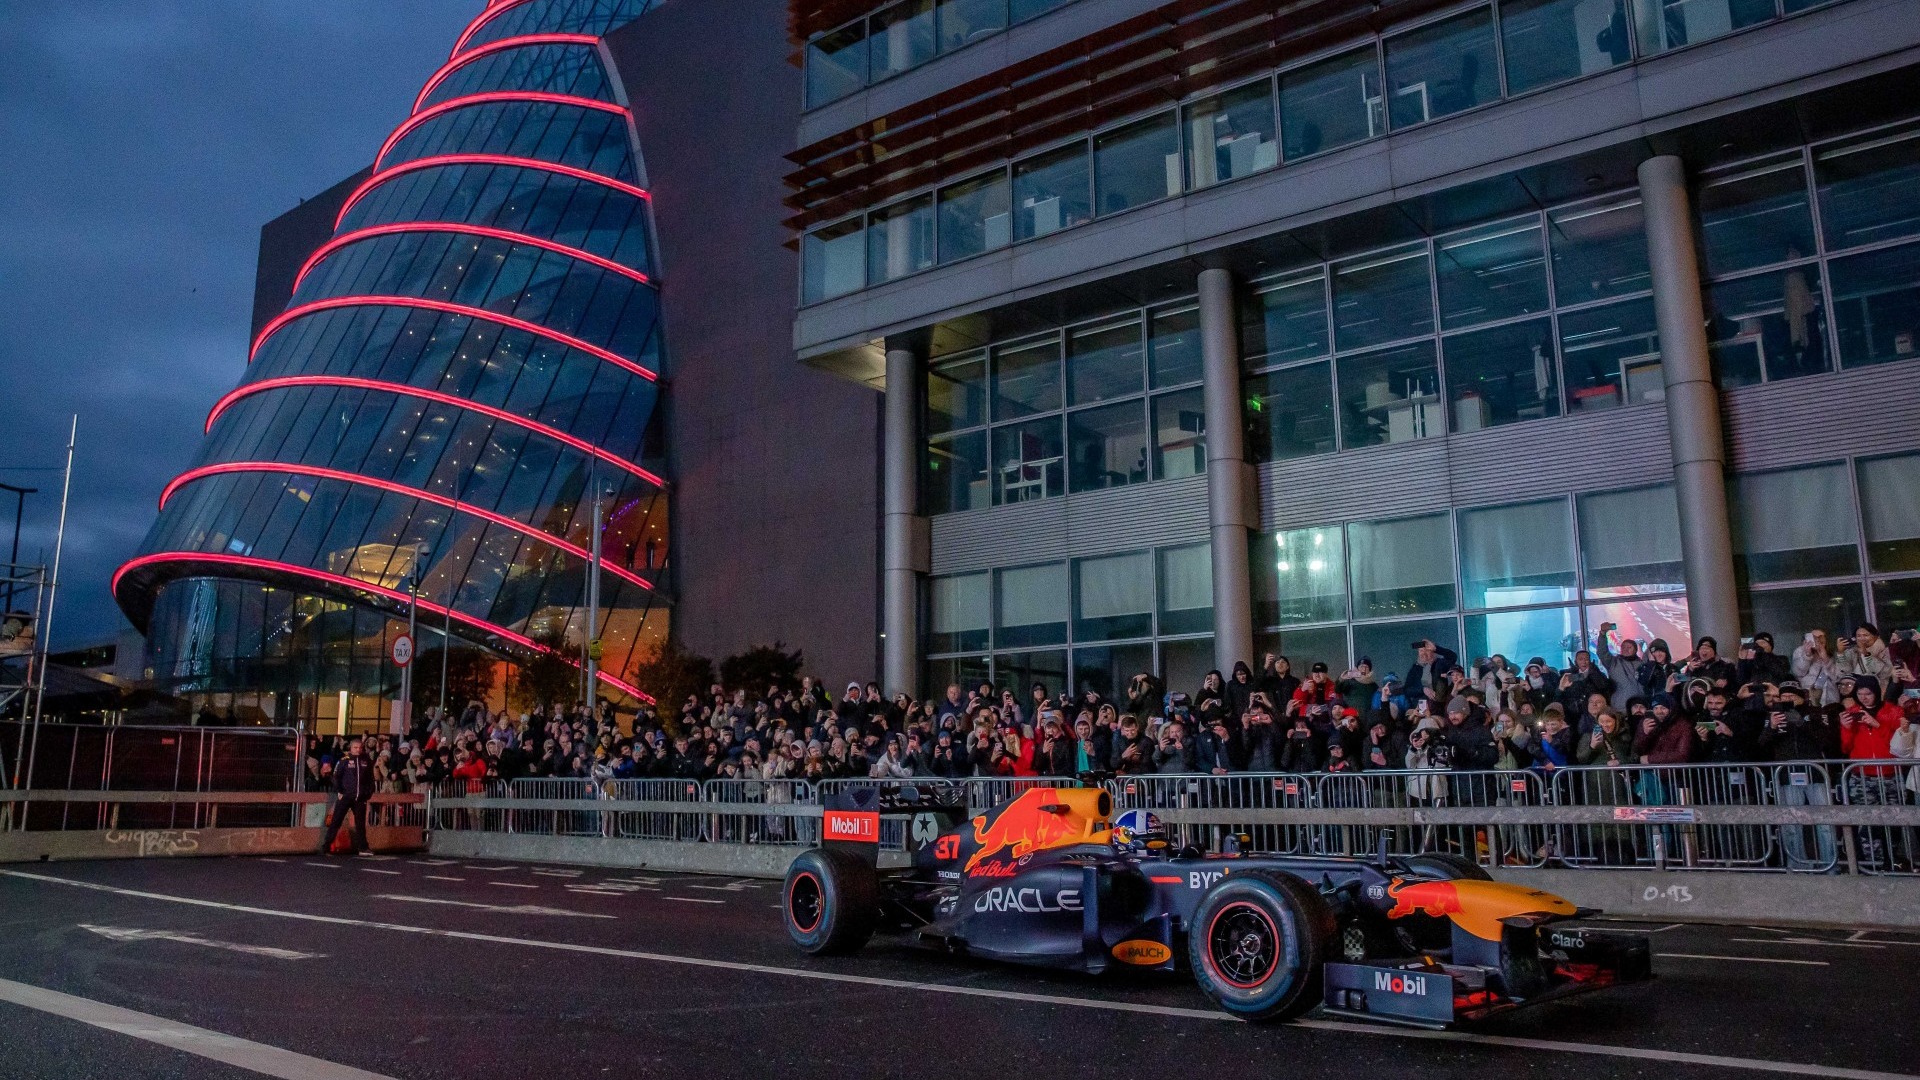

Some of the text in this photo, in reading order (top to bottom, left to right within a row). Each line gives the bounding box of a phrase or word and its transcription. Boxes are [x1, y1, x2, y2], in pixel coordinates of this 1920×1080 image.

[395, 648, 411, 658] TAXI
[831, 816, 871, 835] Mobil 1
[934, 835, 961, 859] 37
[974, 887, 1084, 912] ORACLE
[1368, 887, 1383, 897] FIA
[1551, 932, 1585, 948] Claro
[1127, 947, 1164, 958] RAUCH
[1375, 971, 1426, 996] Mobil
